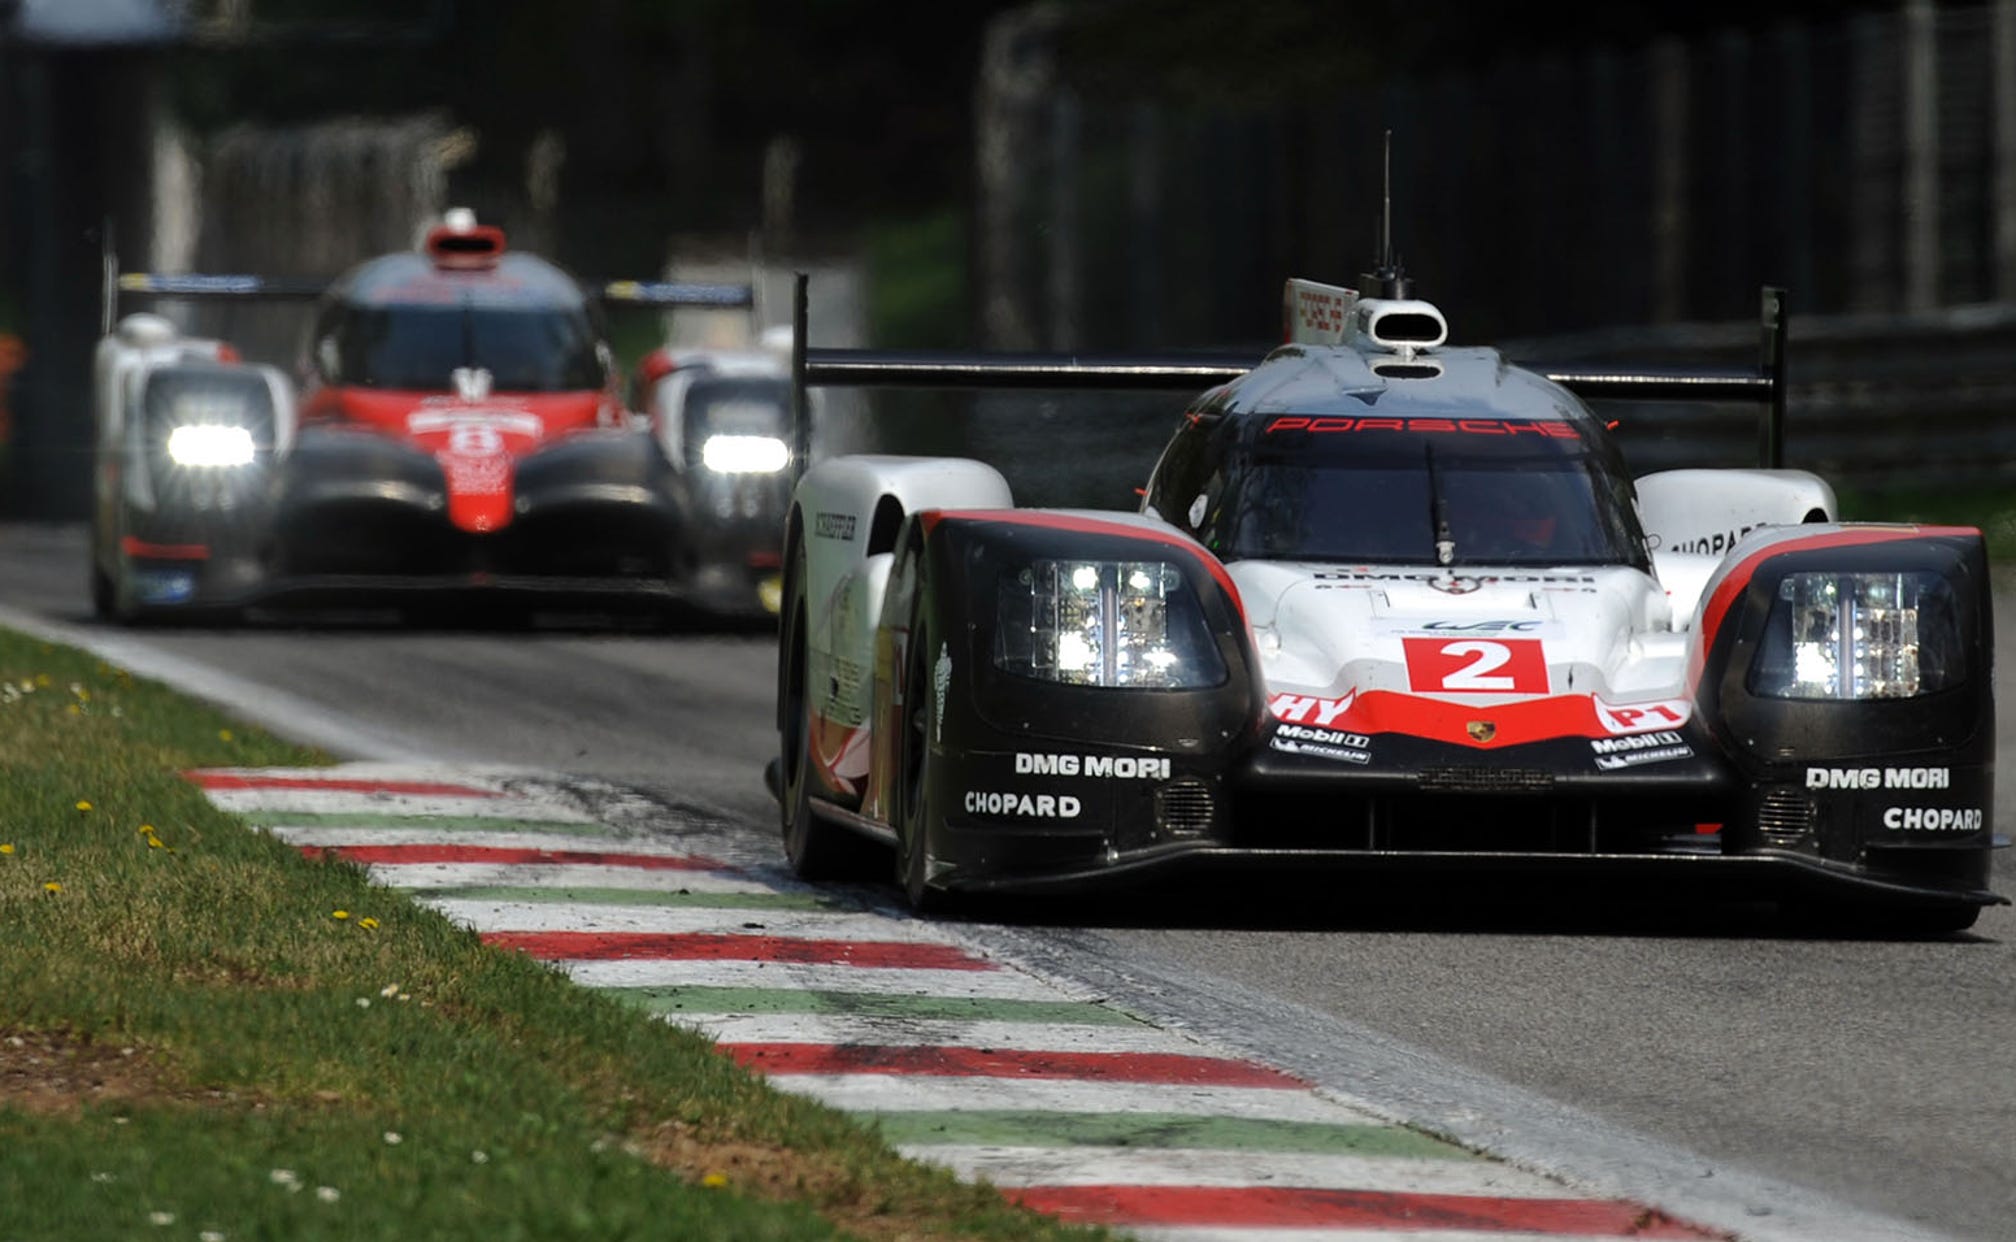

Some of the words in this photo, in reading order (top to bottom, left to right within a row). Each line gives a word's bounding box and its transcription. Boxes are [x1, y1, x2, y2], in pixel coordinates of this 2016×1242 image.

[1266, 417, 1580, 439] PORSCHE
[1422, 620, 1542, 632] WEC
[1440, 640, 1515, 689] 2
[1270, 694, 1354, 725] HY
[1607, 704, 1682, 727] P1
[1277, 724, 1345, 745] Mobil
[1591, 733, 1659, 754] Mobil
[1300, 743, 1367, 760] MICHELIN
[1625, 746, 1688, 761] MICHELIN
[1015, 753, 1080, 776] DMG
[1085, 756, 1170, 778] MORI
[1806, 768, 1881, 789] DMG
[1884, 768, 1949, 789] MORI
[965, 790, 1081, 818] CHOPARD
[1883, 808, 1982, 830] CHOPARD
